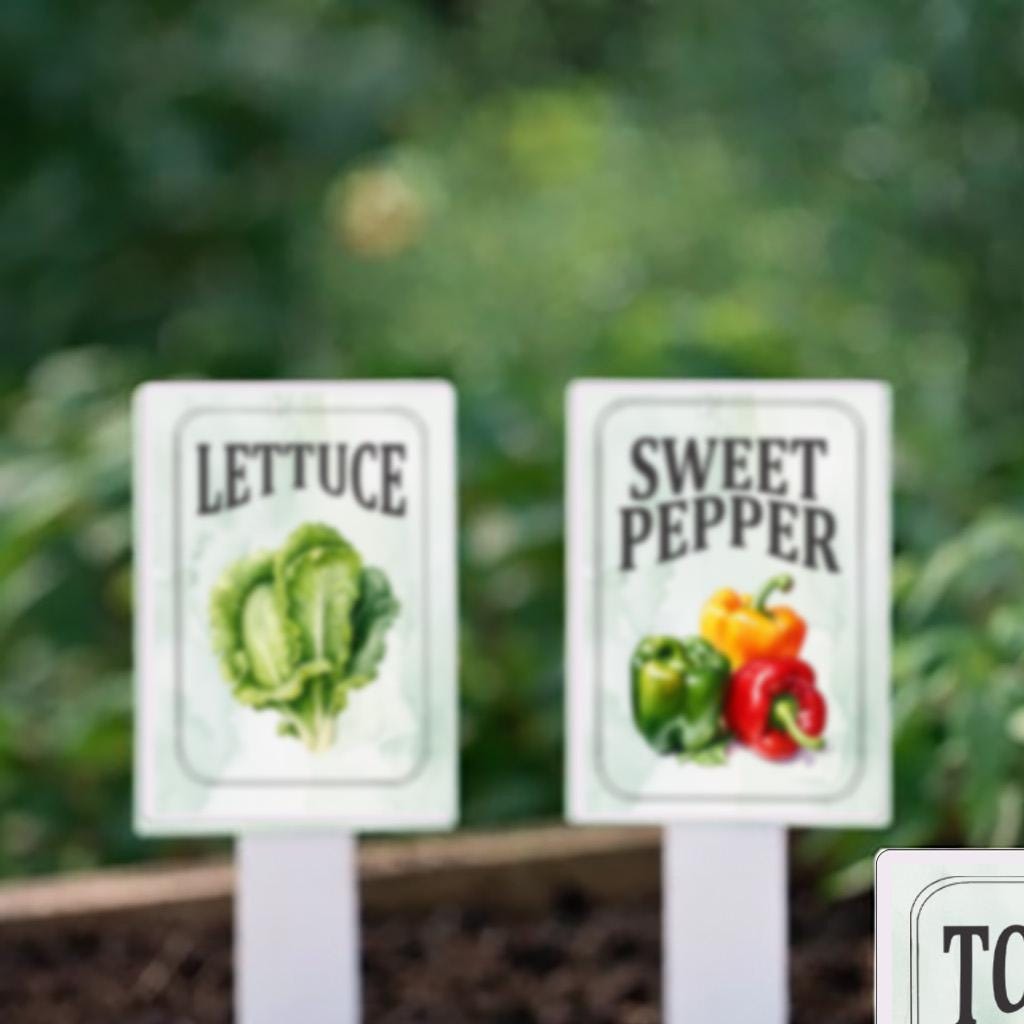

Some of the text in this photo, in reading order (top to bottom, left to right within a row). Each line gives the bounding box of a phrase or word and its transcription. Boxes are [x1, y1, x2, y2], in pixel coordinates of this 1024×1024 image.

[196, 442, 408, 517] LETTUCE
[629, 435, 829, 501] SWEET
[619, 494, 840, 573] PEPPER
